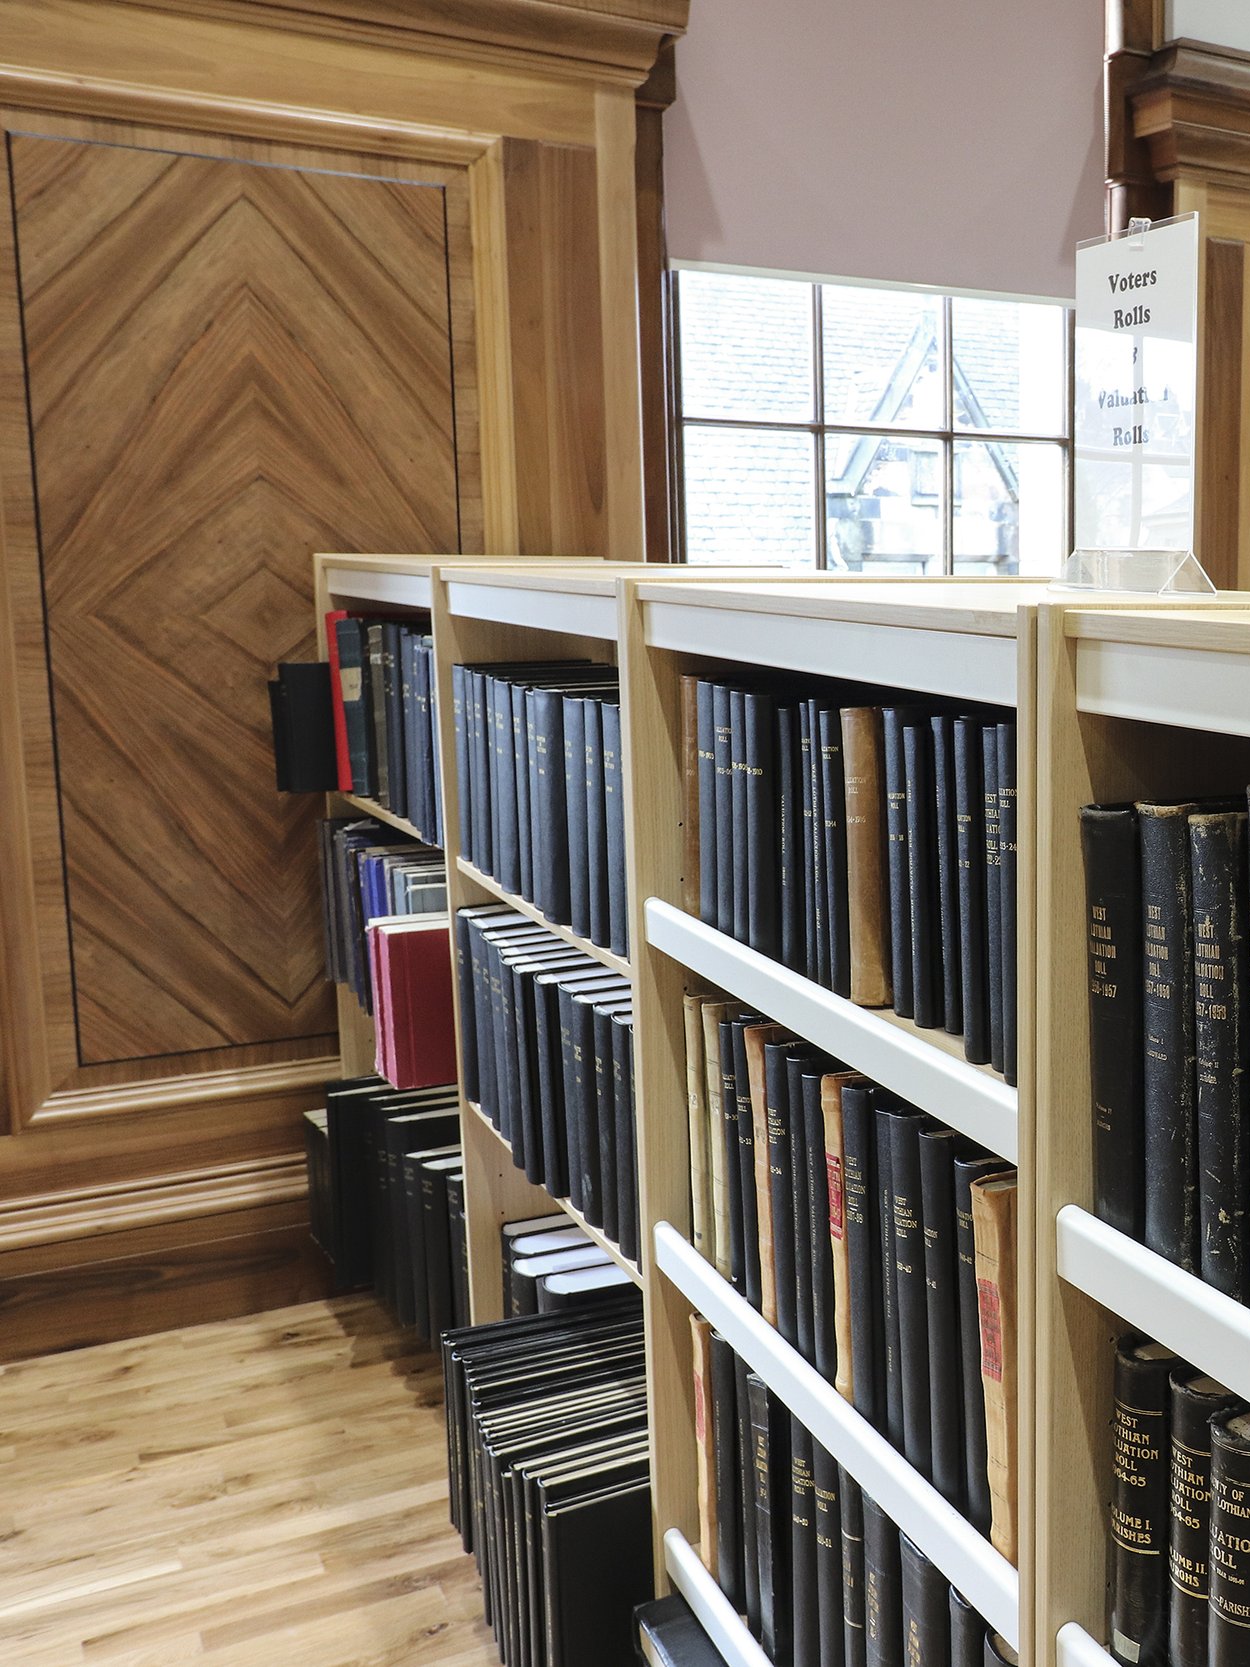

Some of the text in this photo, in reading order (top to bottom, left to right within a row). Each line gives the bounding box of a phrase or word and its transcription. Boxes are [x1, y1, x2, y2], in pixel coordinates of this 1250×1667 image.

[1108, 270, 1157, 294] Voters
[1113, 304, 1151, 329] Rolls
[1098, 384, 1169, 409] Valuati
[1112, 425, 1149, 447] Rolls
[1116, 1407, 1139, 1429] WEST
[1231, 1488, 1245, 1502] OF
